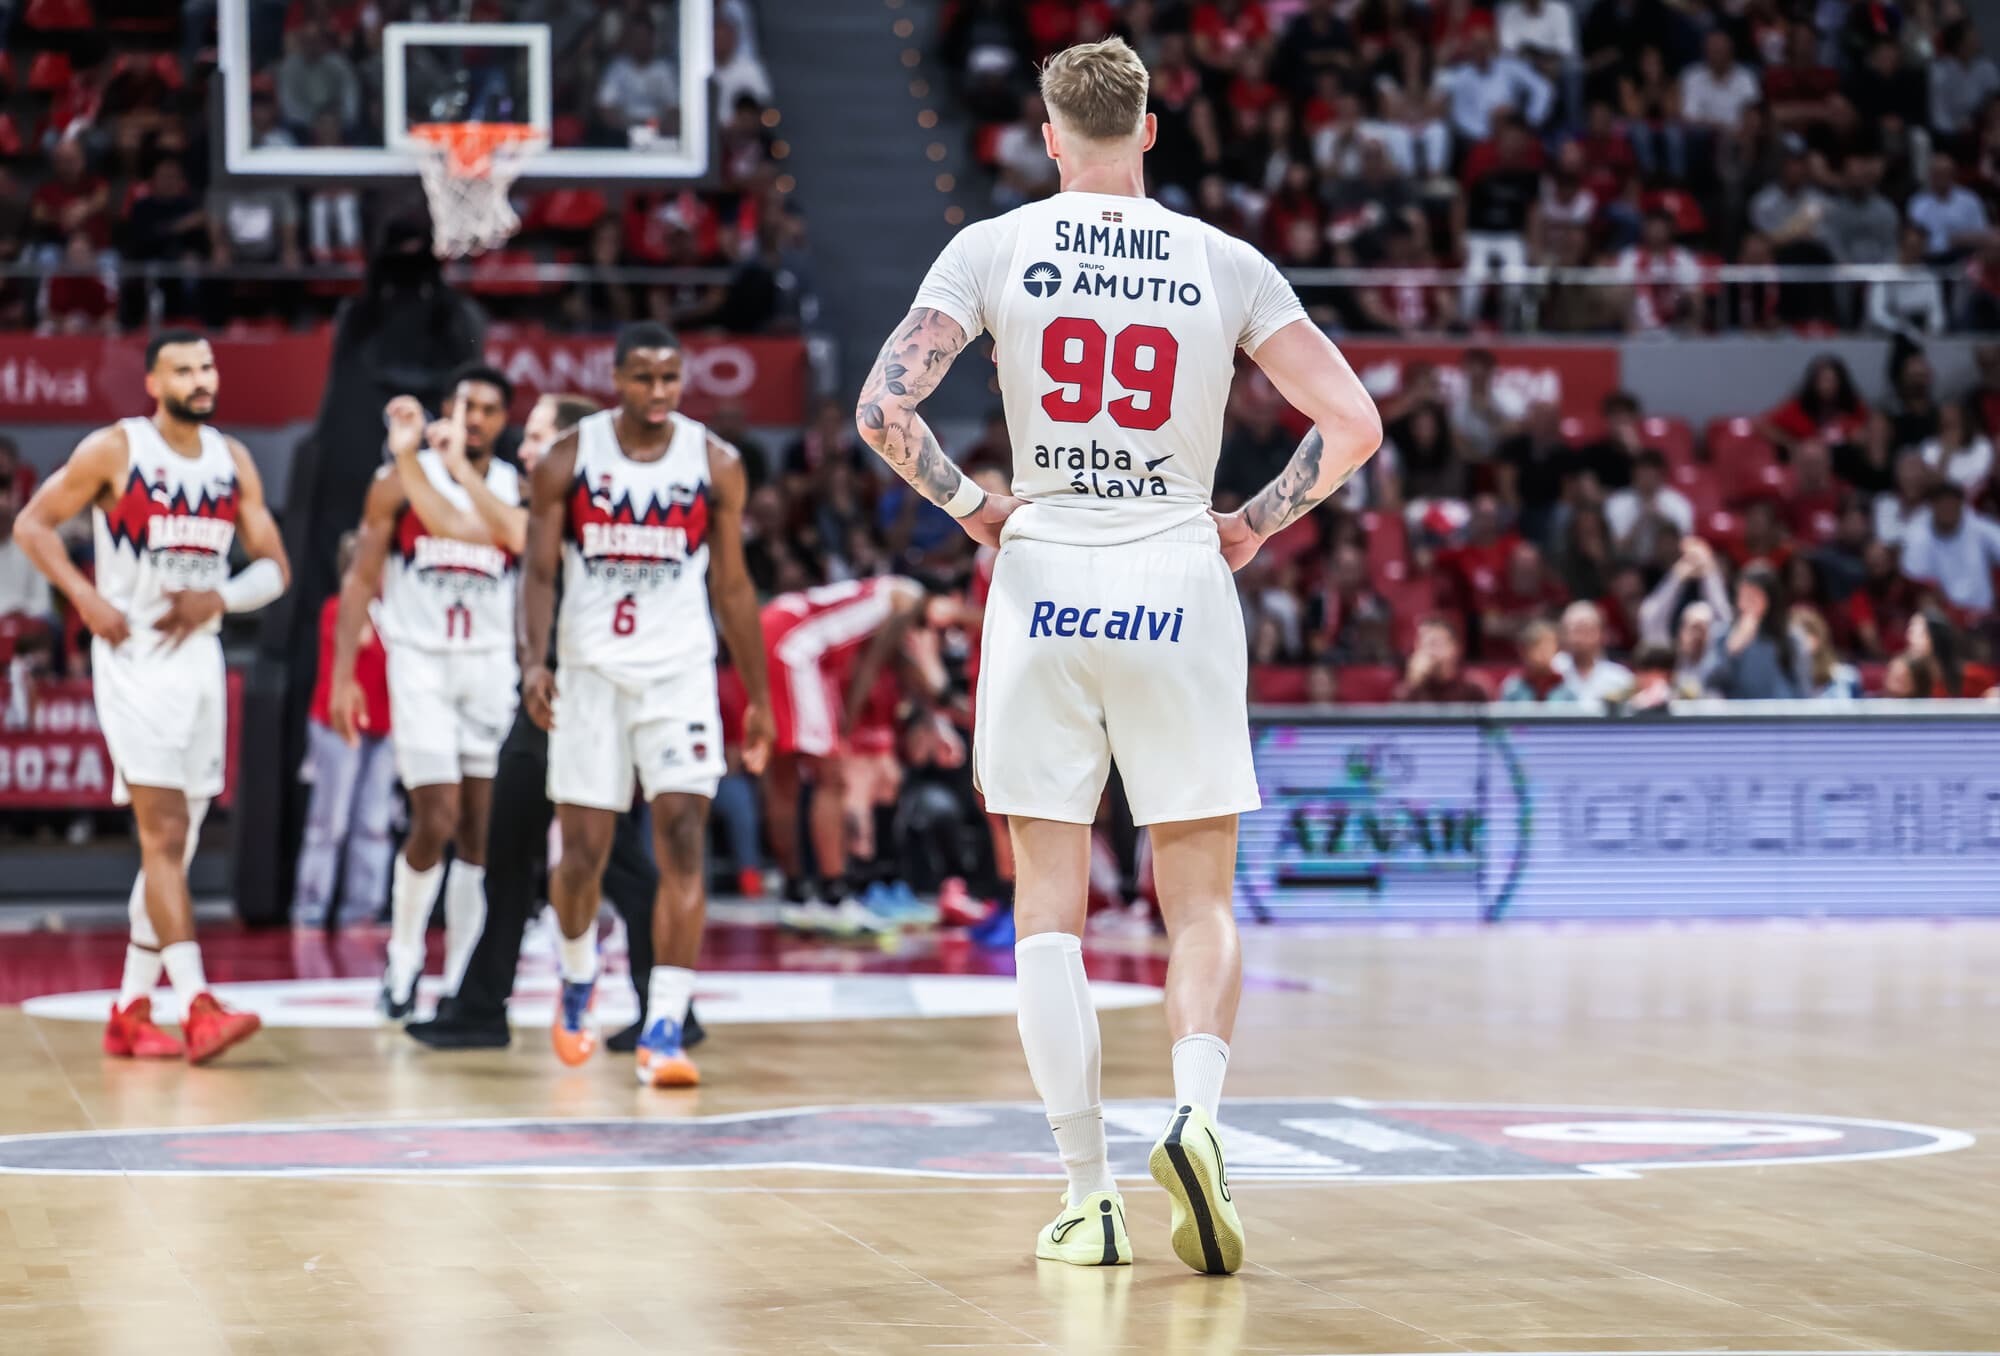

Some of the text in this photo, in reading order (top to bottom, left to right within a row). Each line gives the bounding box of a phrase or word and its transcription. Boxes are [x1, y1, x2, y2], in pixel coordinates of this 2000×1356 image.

[1055, 220, 1170, 261] SAMANIC
[1078, 262, 1105, 271] GRUPO
[1072, 271, 1201, 306] AMUTIO
[1041, 316, 1179, 431] 99
[1034, 439, 1132, 471] araba
[611, 598, 637, 637] 6
[1029, 600, 1184, 643] Recalvi
